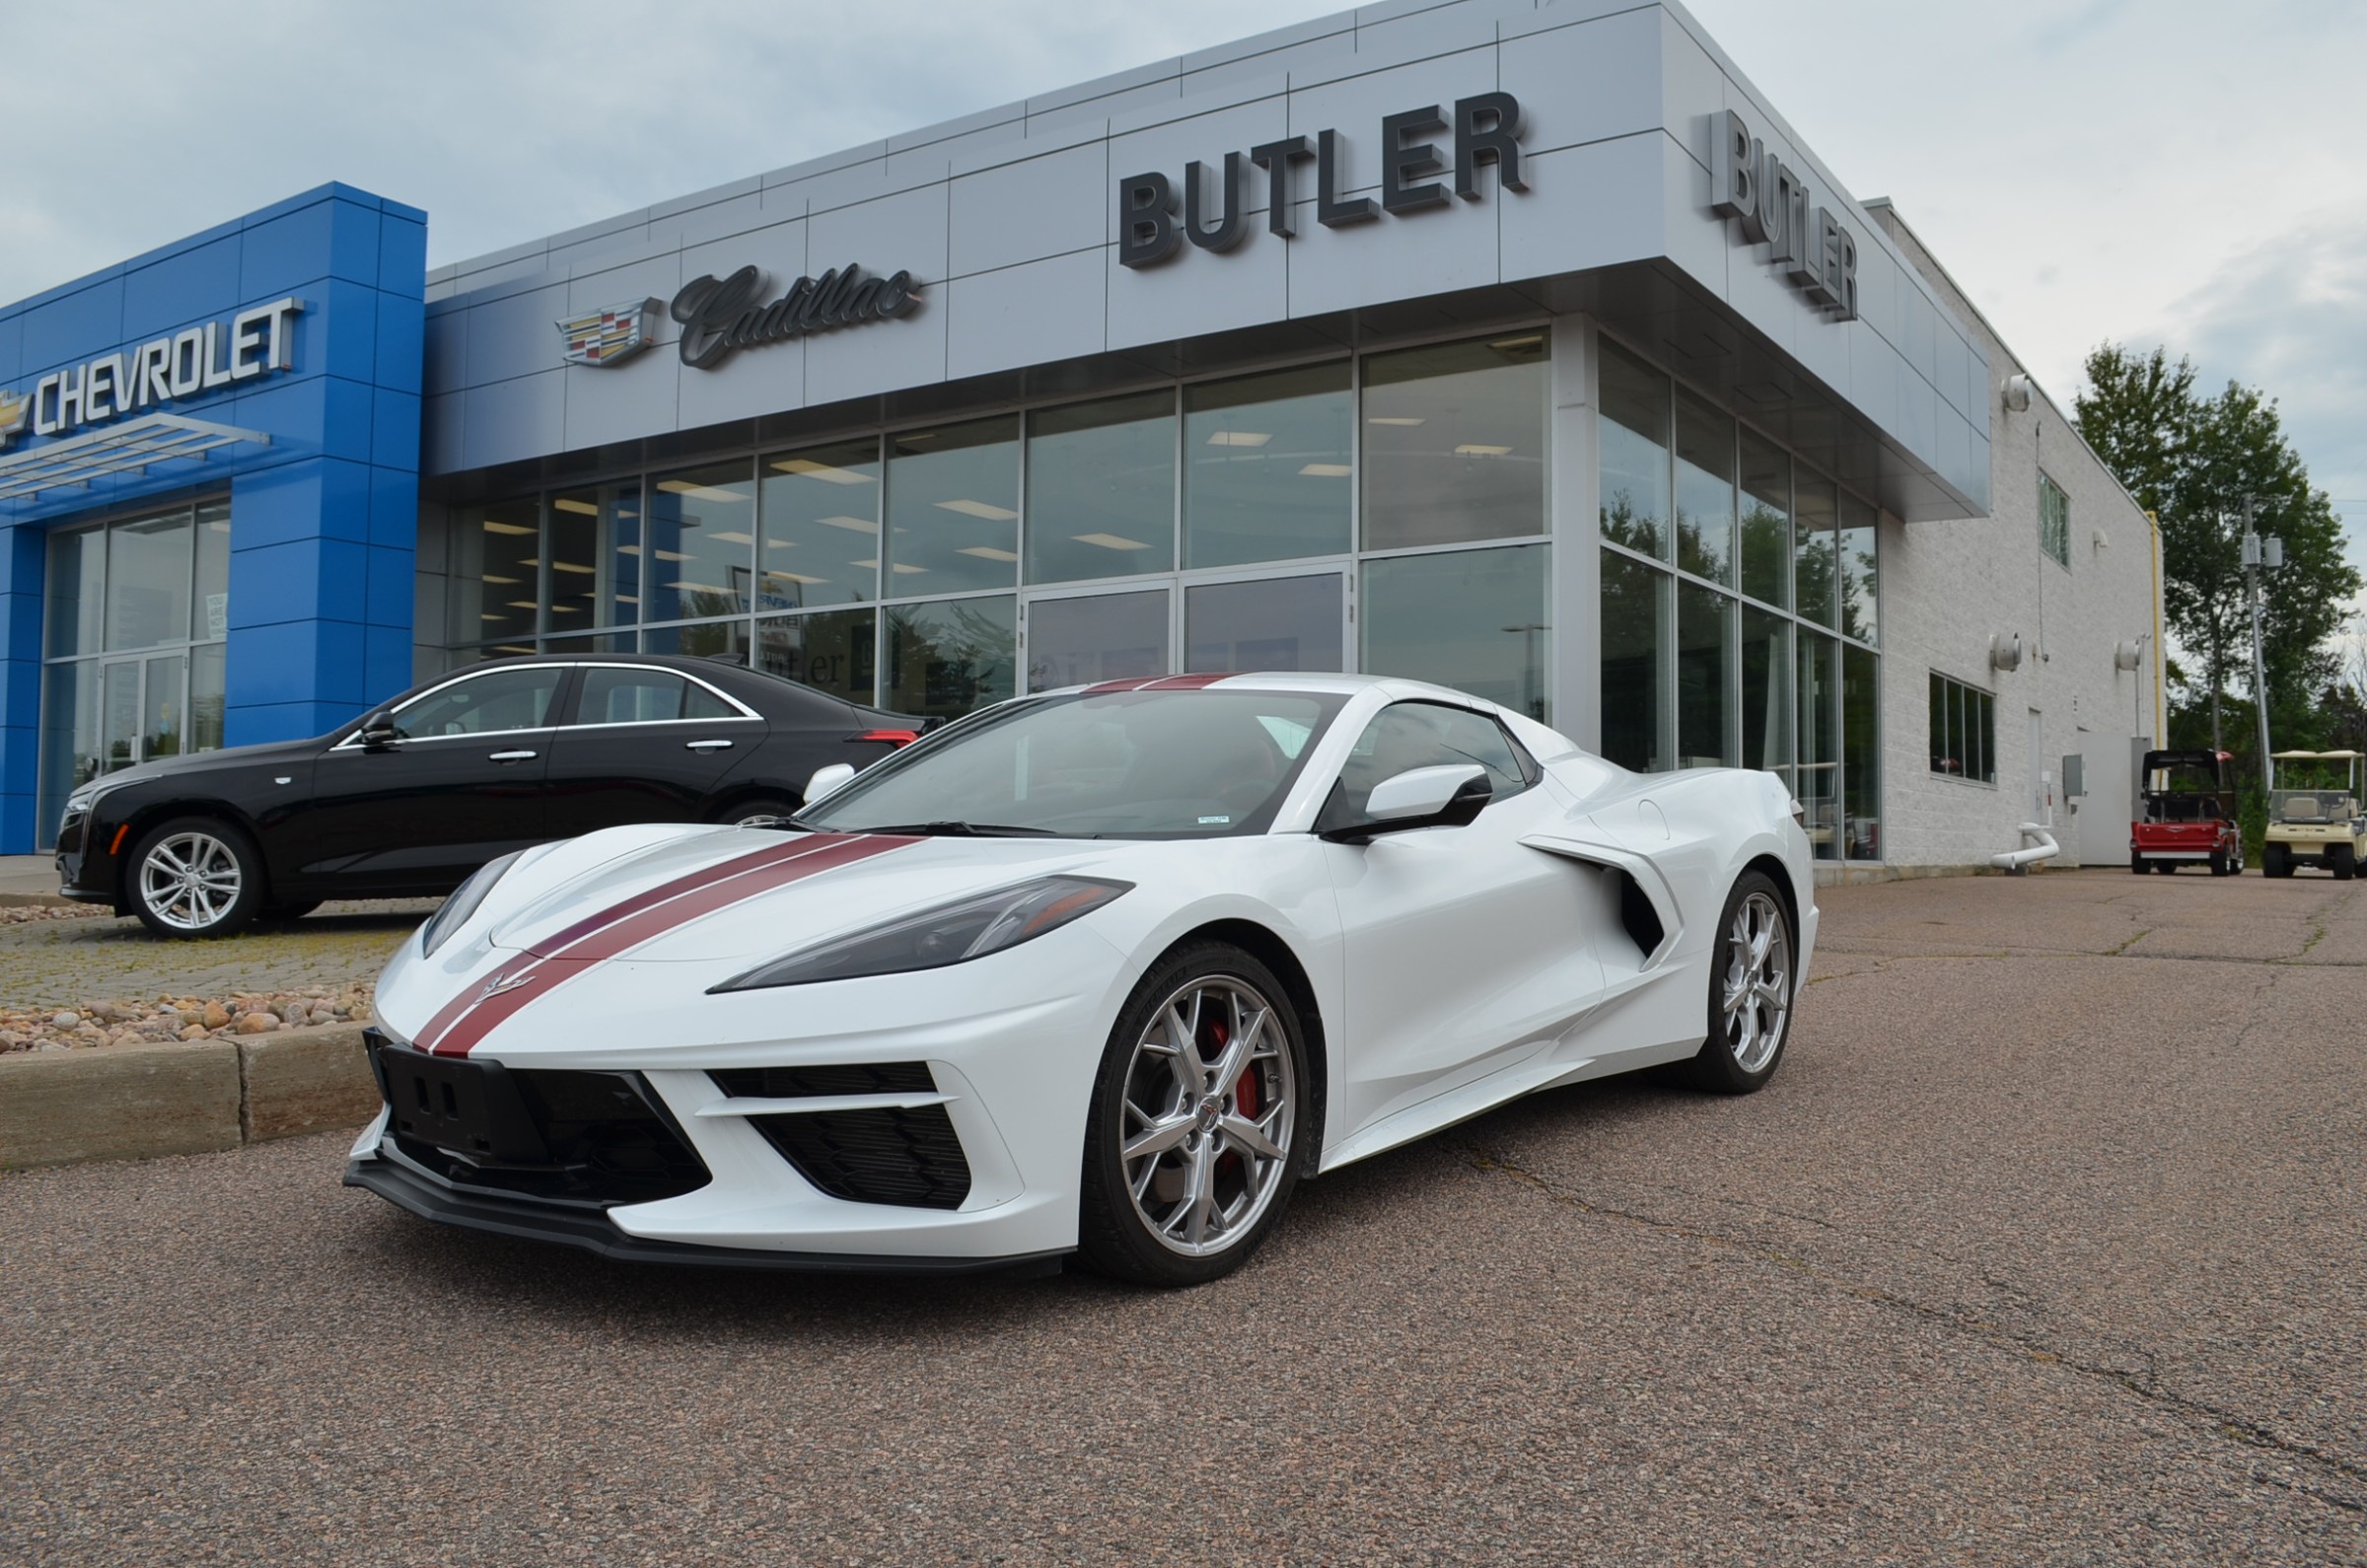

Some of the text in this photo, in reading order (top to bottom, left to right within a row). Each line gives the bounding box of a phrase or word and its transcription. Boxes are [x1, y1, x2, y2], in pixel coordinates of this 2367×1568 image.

[1118, 90, 1525, 266] BUTLER
[1711, 108, 1858, 321] BUTLER
[33, 296, 300, 436] CHEVROLET
[670, 261, 917, 369] Cadillac
